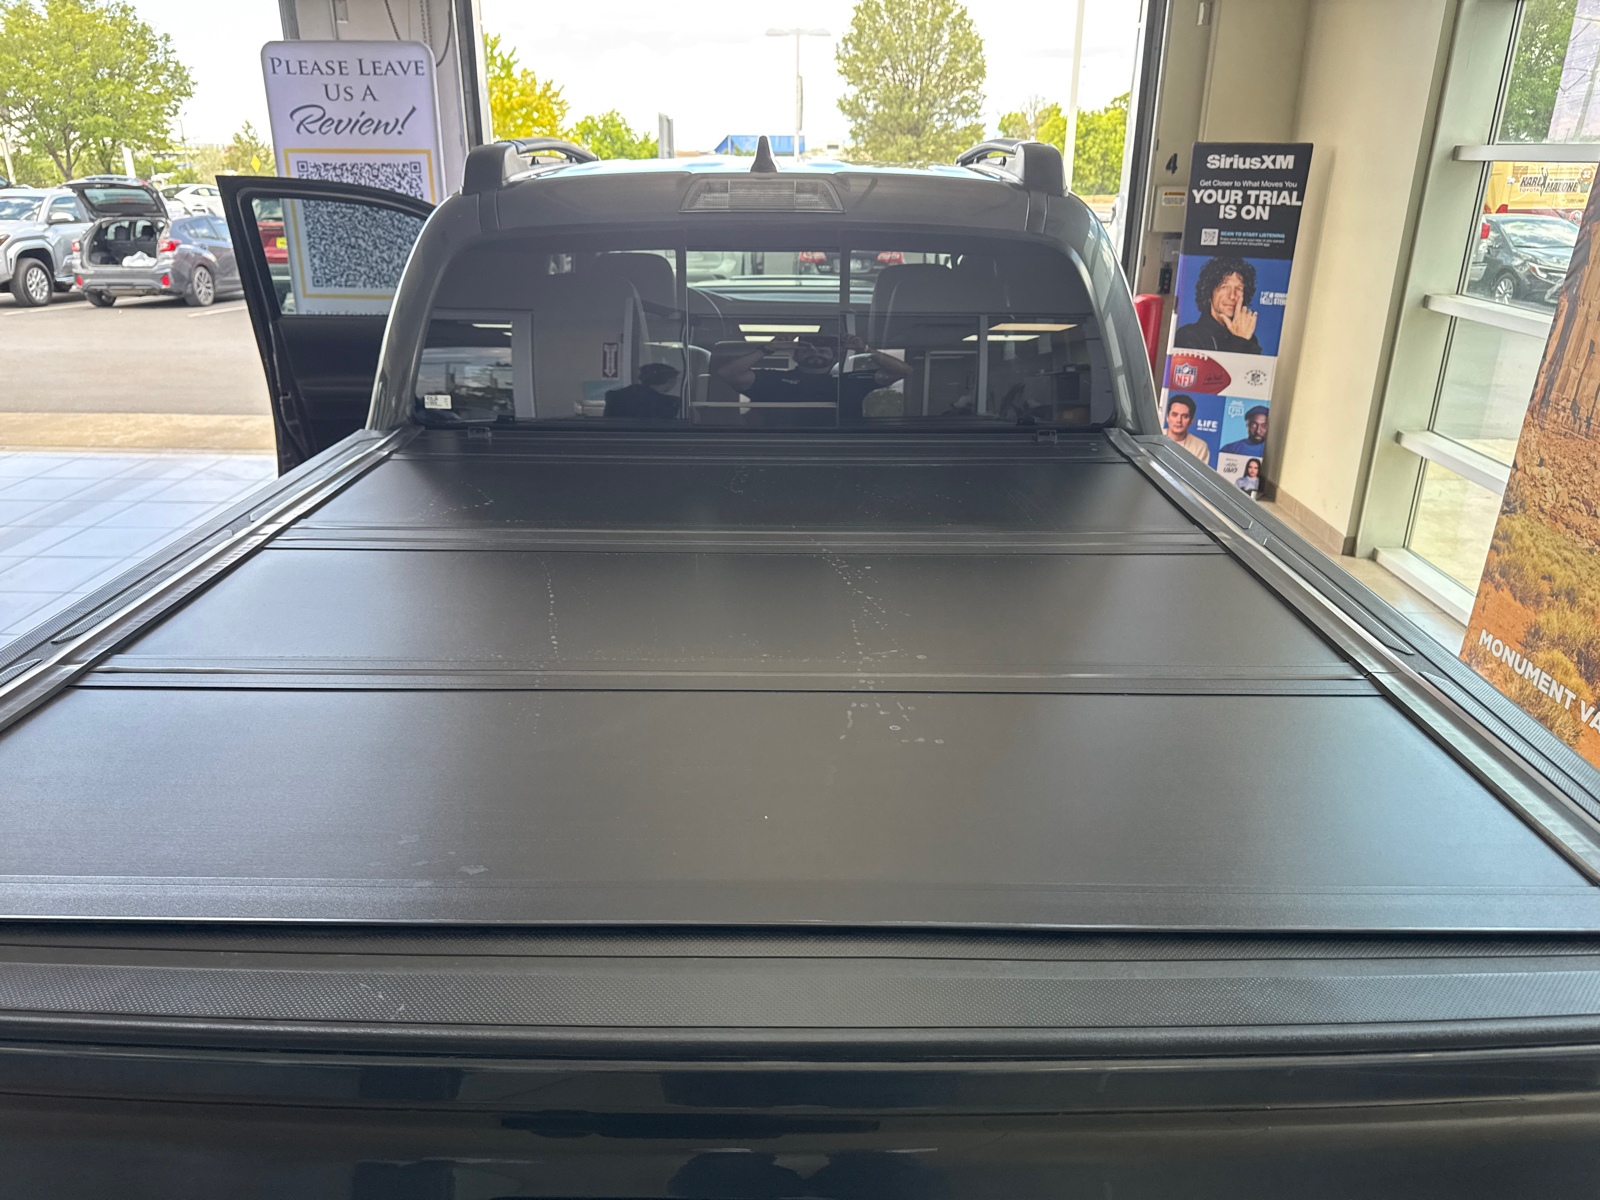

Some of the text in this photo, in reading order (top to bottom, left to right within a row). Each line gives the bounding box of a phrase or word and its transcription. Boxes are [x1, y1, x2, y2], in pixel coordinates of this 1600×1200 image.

[269, 57, 425, 76] PLEASE LEAVE
[322, 83, 379, 102] US A
[289, 104, 417, 136] Review!
[1165, 153, 1178, 175] 4
[1206, 154, 1295, 169] SiriusXM
[1200, 179, 1298, 188] Get Closer to What Moves You
[1520, 176, 1578, 192] KARL MALONE
[1192, 189, 1243, 204] YOUR
[1247, 189, 1302, 206] TRIAL
[1219, 204, 1270, 220] IS ON
[1176, 373, 1193, 387] NFL
[1197, 419, 1218, 429] LIFE
[1478, 628, 1577, 710] MONUMENT
